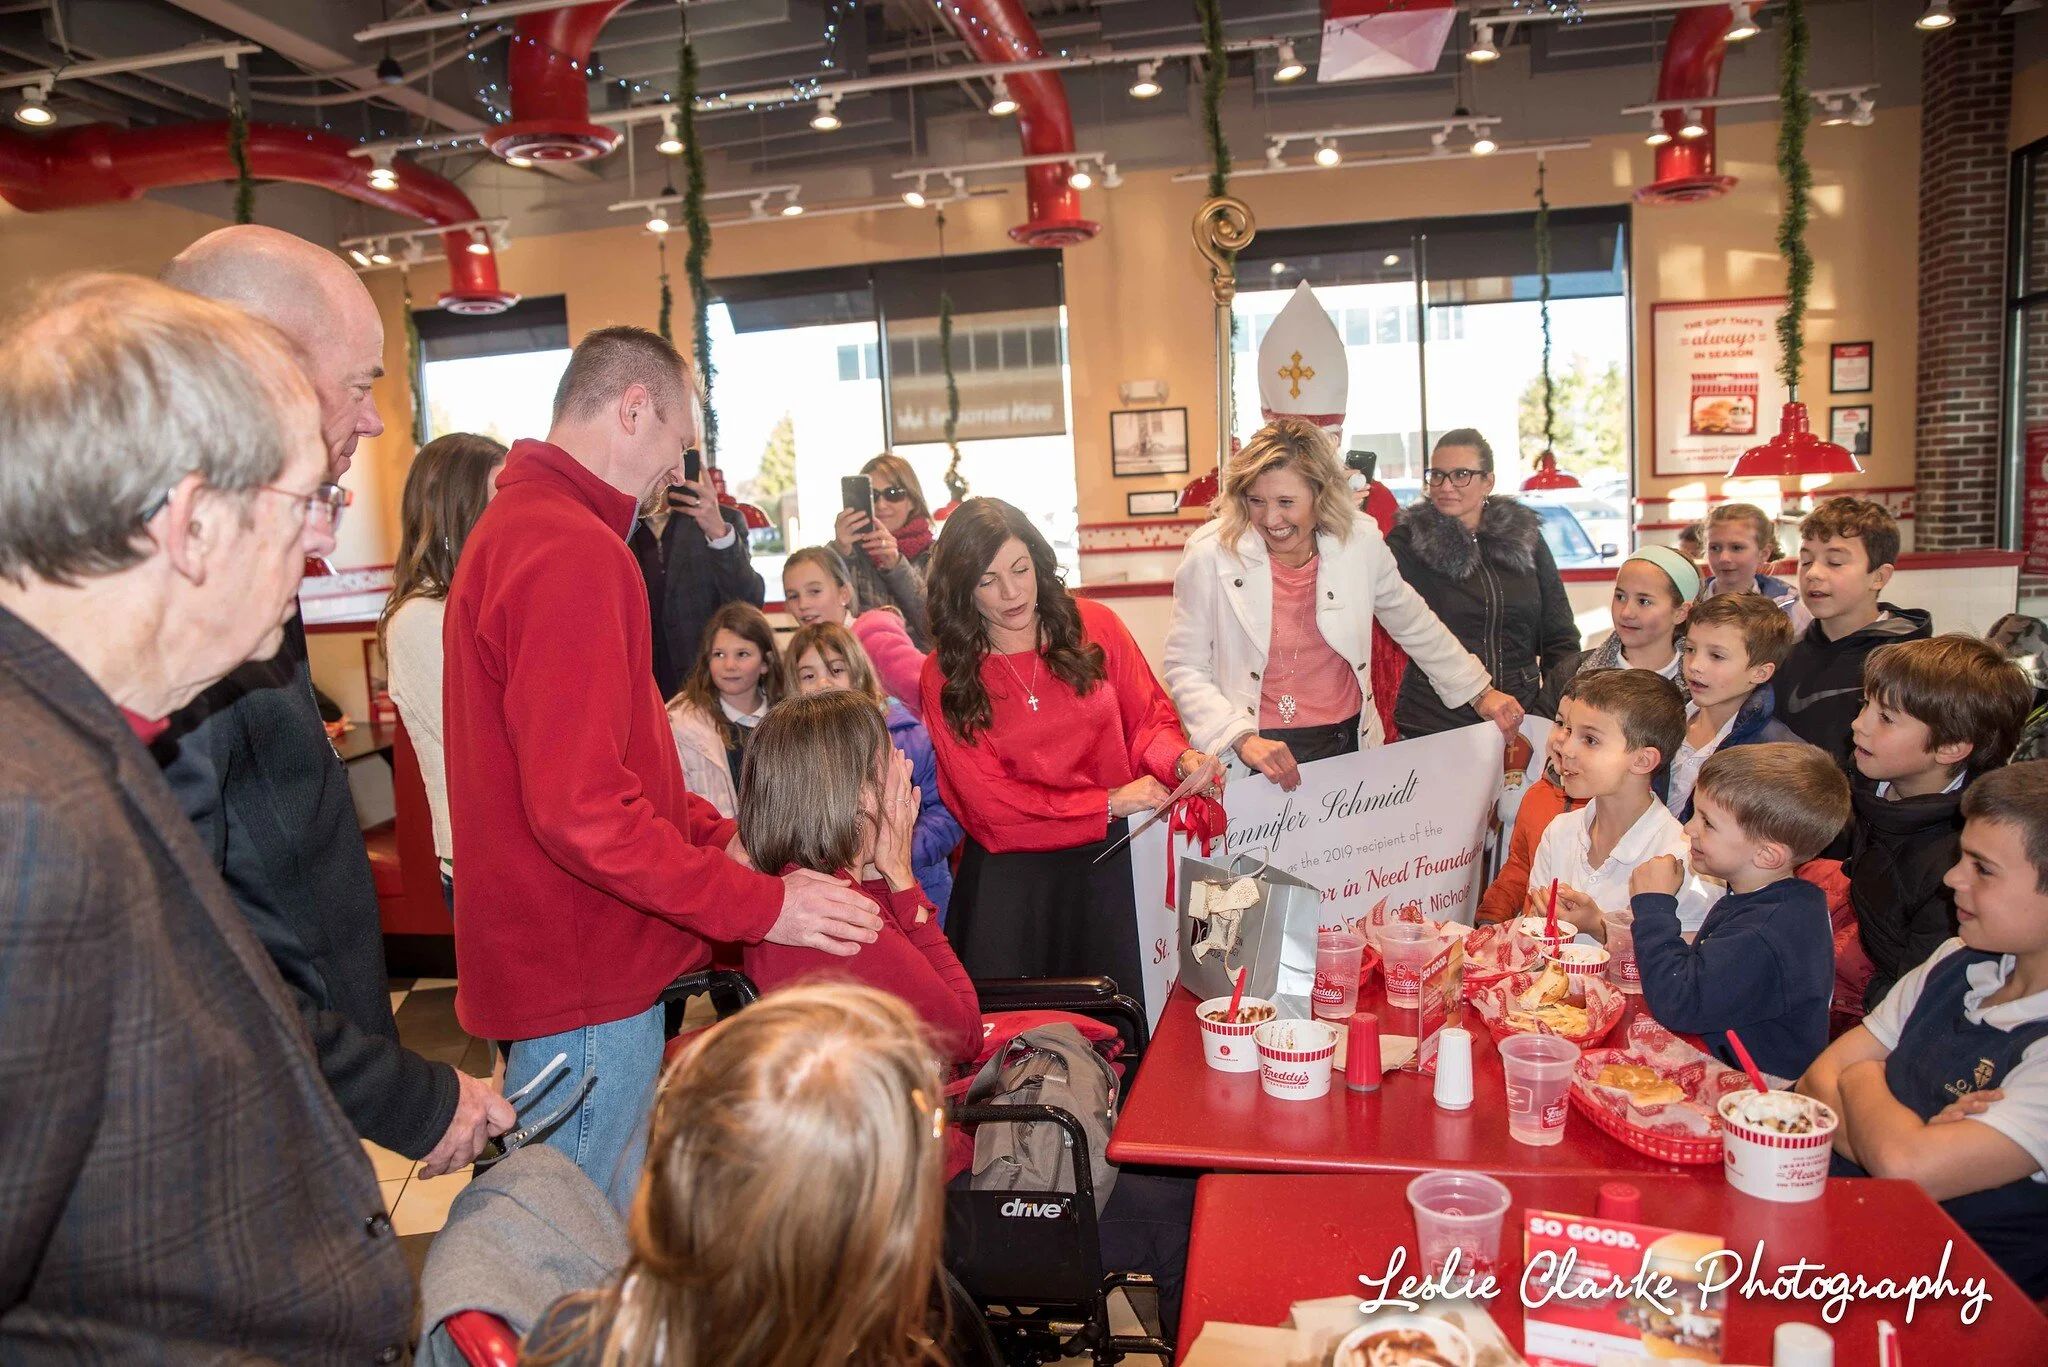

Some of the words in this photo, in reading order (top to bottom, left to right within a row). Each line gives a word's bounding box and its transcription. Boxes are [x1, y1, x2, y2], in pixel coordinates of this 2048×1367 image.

[1692, 330, 1756, 348] always
[1709, 349, 1753, 358] SEASON
[1319, 769, 1419, 823] Schmidt
[1301, 852, 1320, 871] the
[1323, 845, 1353, 864] 2019
[1356, 833, 1405, 855] recipient
[1409, 823, 1421, 843] of
[1425, 821, 1443, 837] the
[1343, 878, 1361, 898] in
[1365, 861, 1409, 892] Need
[1153, 938, 1170, 965] St.
[1262, 1063, 1310, 1085] Freddy's
[1000, 1198, 1062, 1219] drive
[1530, 1217, 1563, 1237] SO
[1566, 1223, 1641, 1250] GOOD.
